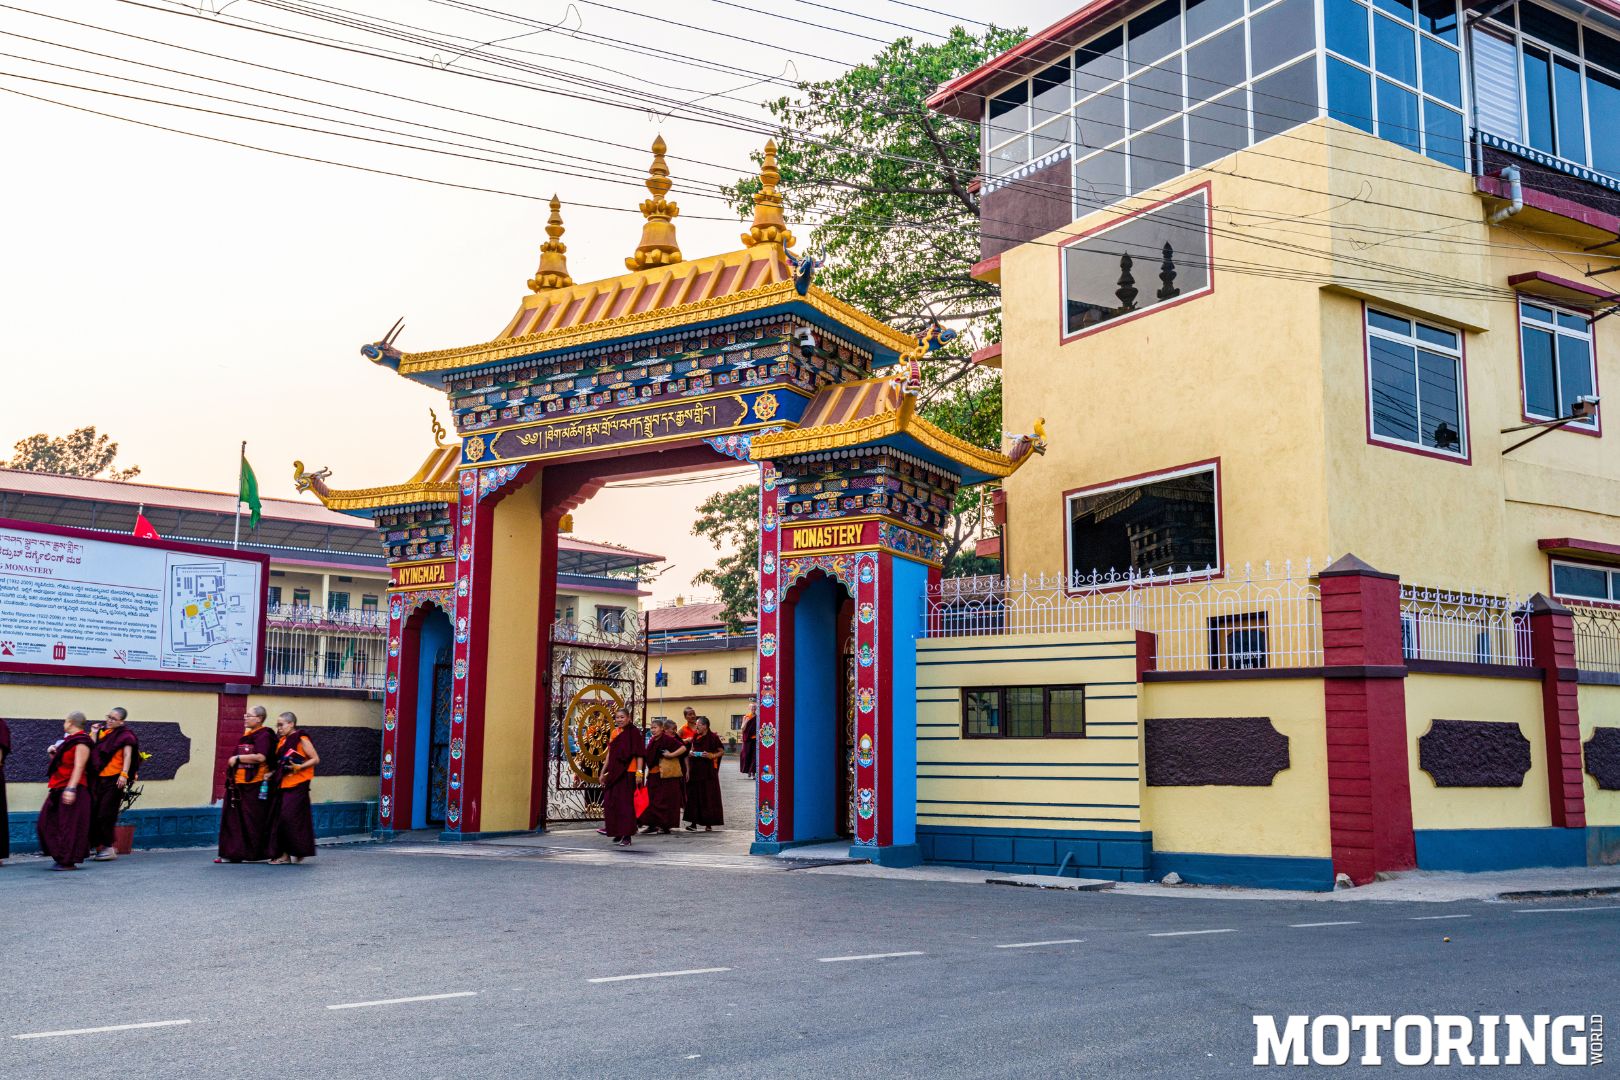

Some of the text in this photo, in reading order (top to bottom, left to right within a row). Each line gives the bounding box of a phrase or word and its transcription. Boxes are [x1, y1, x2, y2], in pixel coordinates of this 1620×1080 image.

[793, 523, 864, 548] MONASTERY
[5, 563, 54, 574] MONASTERY
[399, 565, 446, 584] NYINGMAPA
